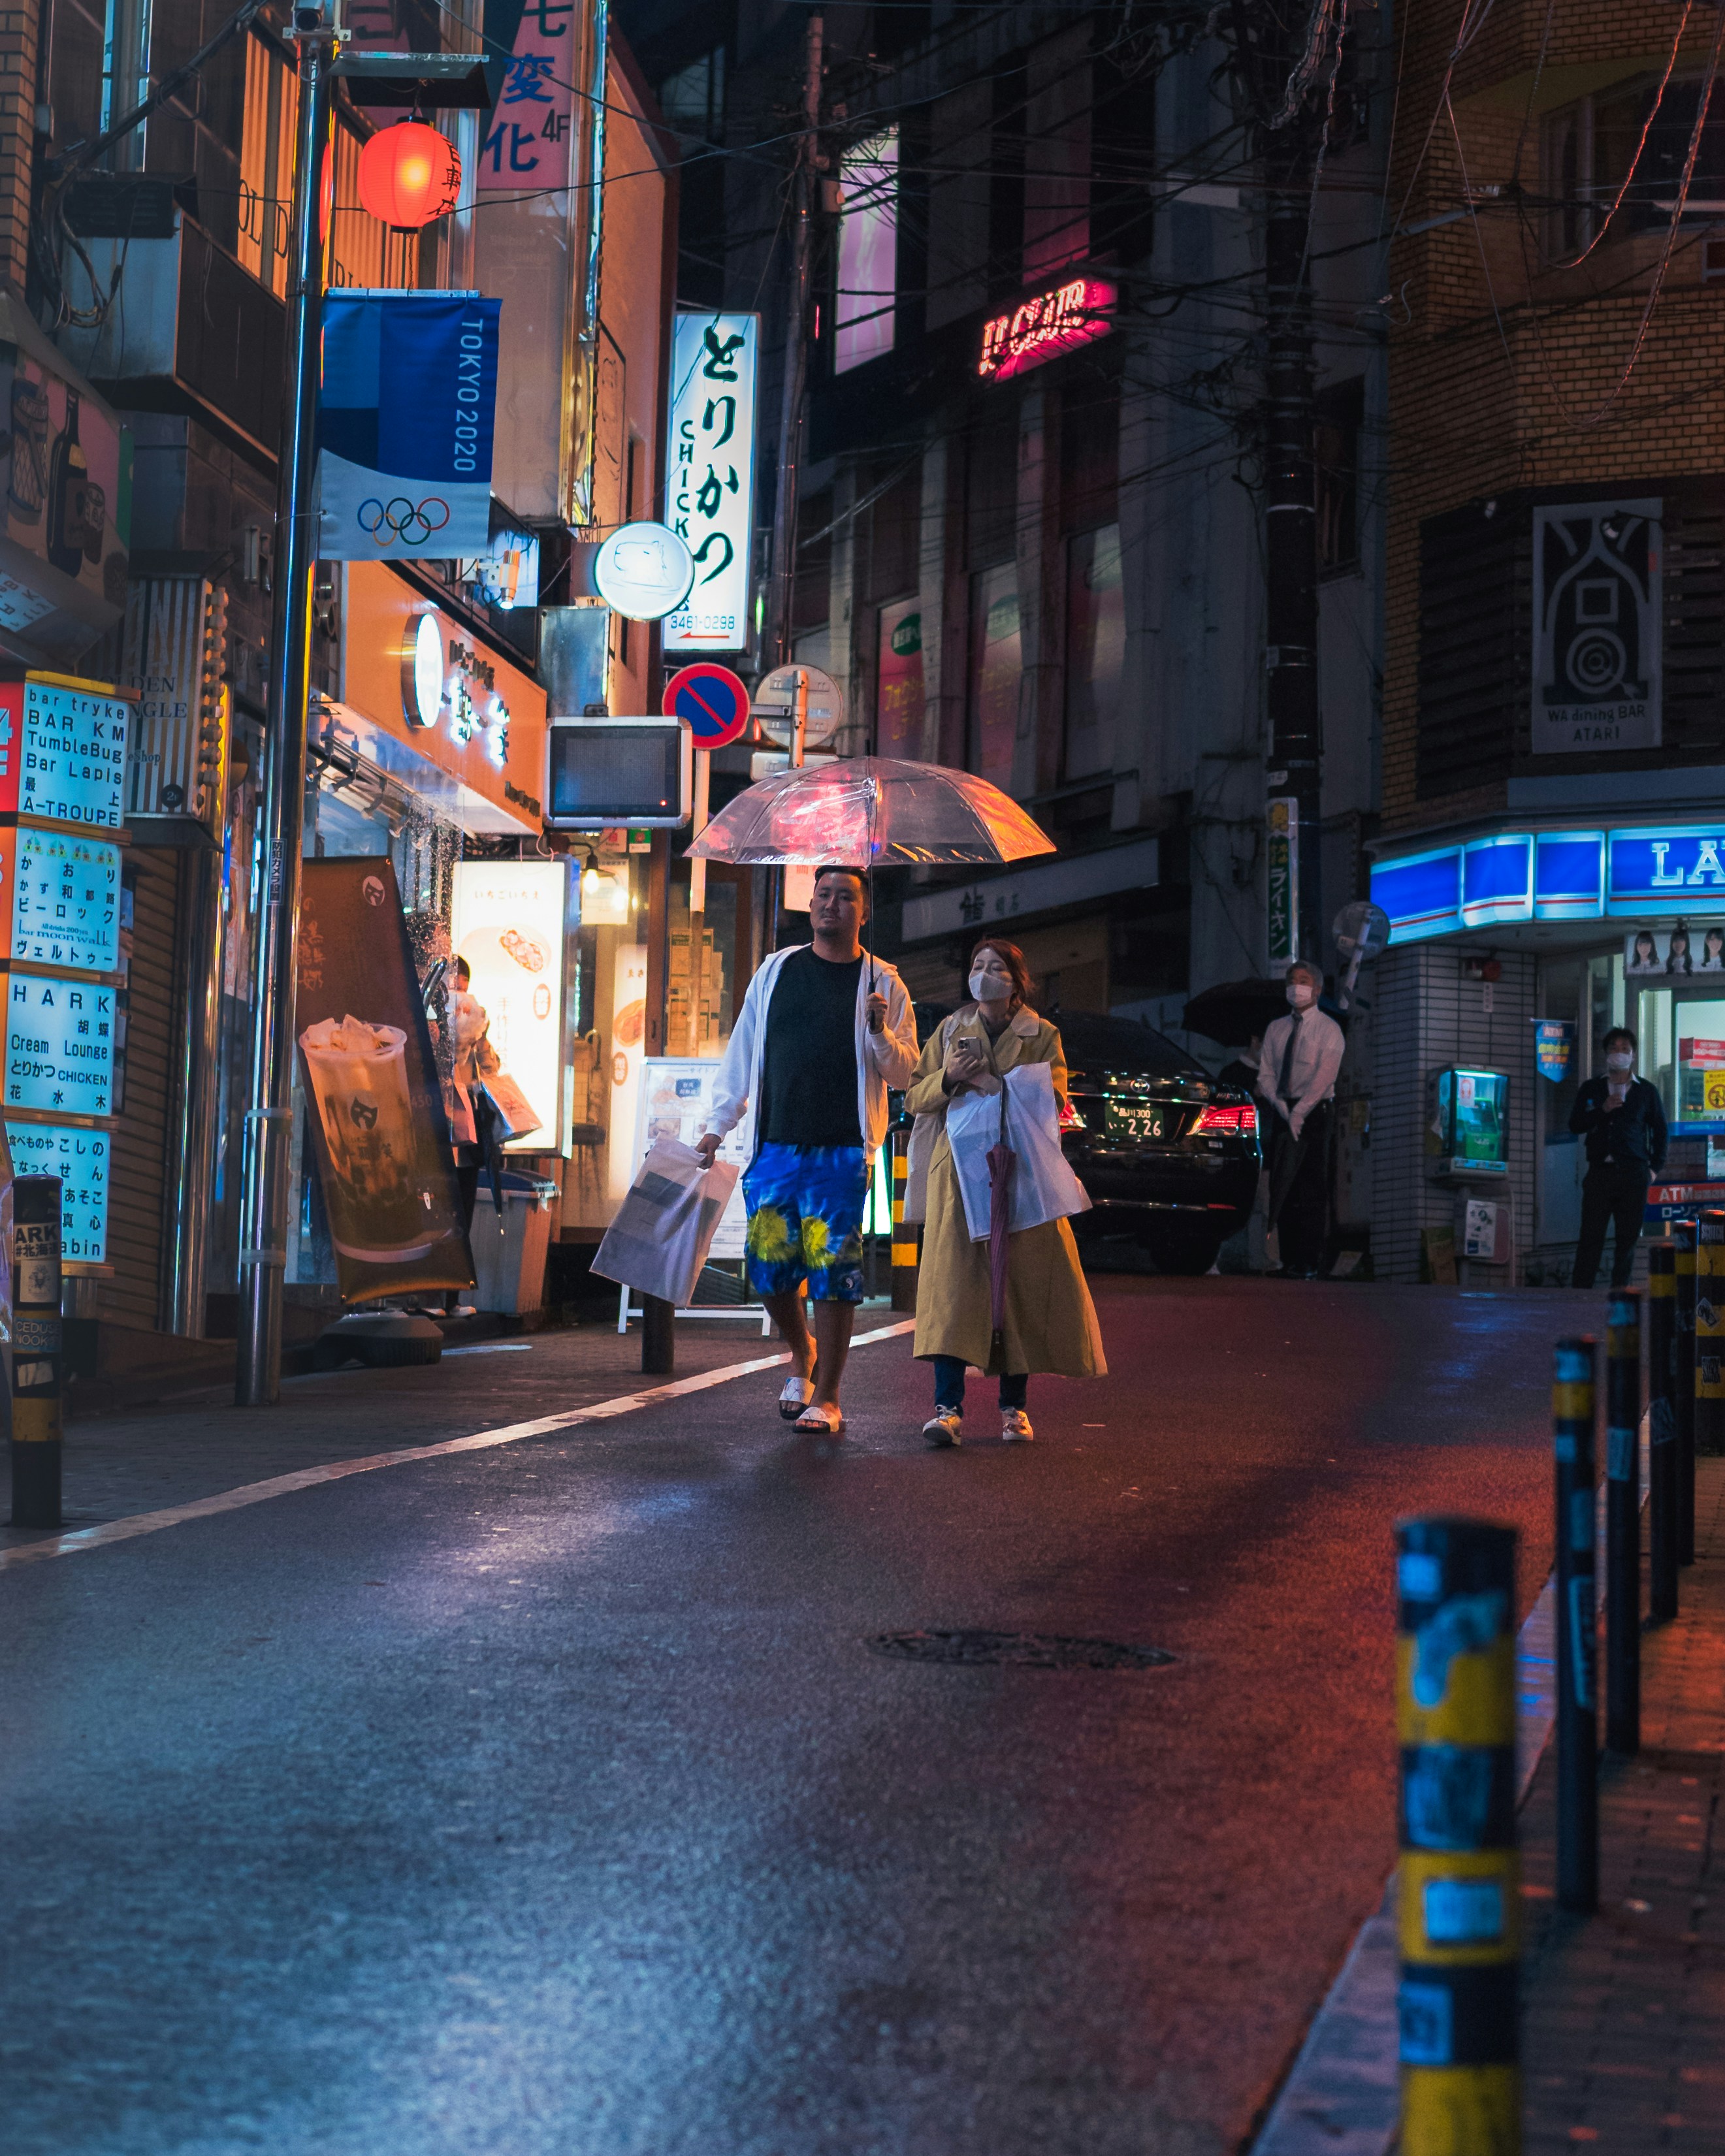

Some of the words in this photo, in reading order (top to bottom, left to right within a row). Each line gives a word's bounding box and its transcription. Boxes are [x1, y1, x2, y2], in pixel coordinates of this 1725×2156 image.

[541, 108, 571, 143] 4F
[457, 318, 483, 403] TOKYO
[453, 410, 479, 472] 2020
[694, 325, 745, 587] とりかつ
[670, 615, 735, 630] 3461-0298
[29, 689, 59, 707] bar
[72, 697, 125, 720] tryke
[1618, 703, 1646, 718] BAR
[28, 709, 74, 732] BAR
[26, 752, 57, 773] Bar
[28, 730, 122, 764] TumbleBug
[23, 796, 118, 827] A-TROUPE
[1651, 840, 1725, 886] LA
[14, 984, 110, 1014] HARK
[11, 1034, 50, 1054] Cream
[65, 1040, 108, 1060] Lounge
[10, 1059, 56, 1078] とりかつ
[57, 1070, 108, 1086] CHICKEN
